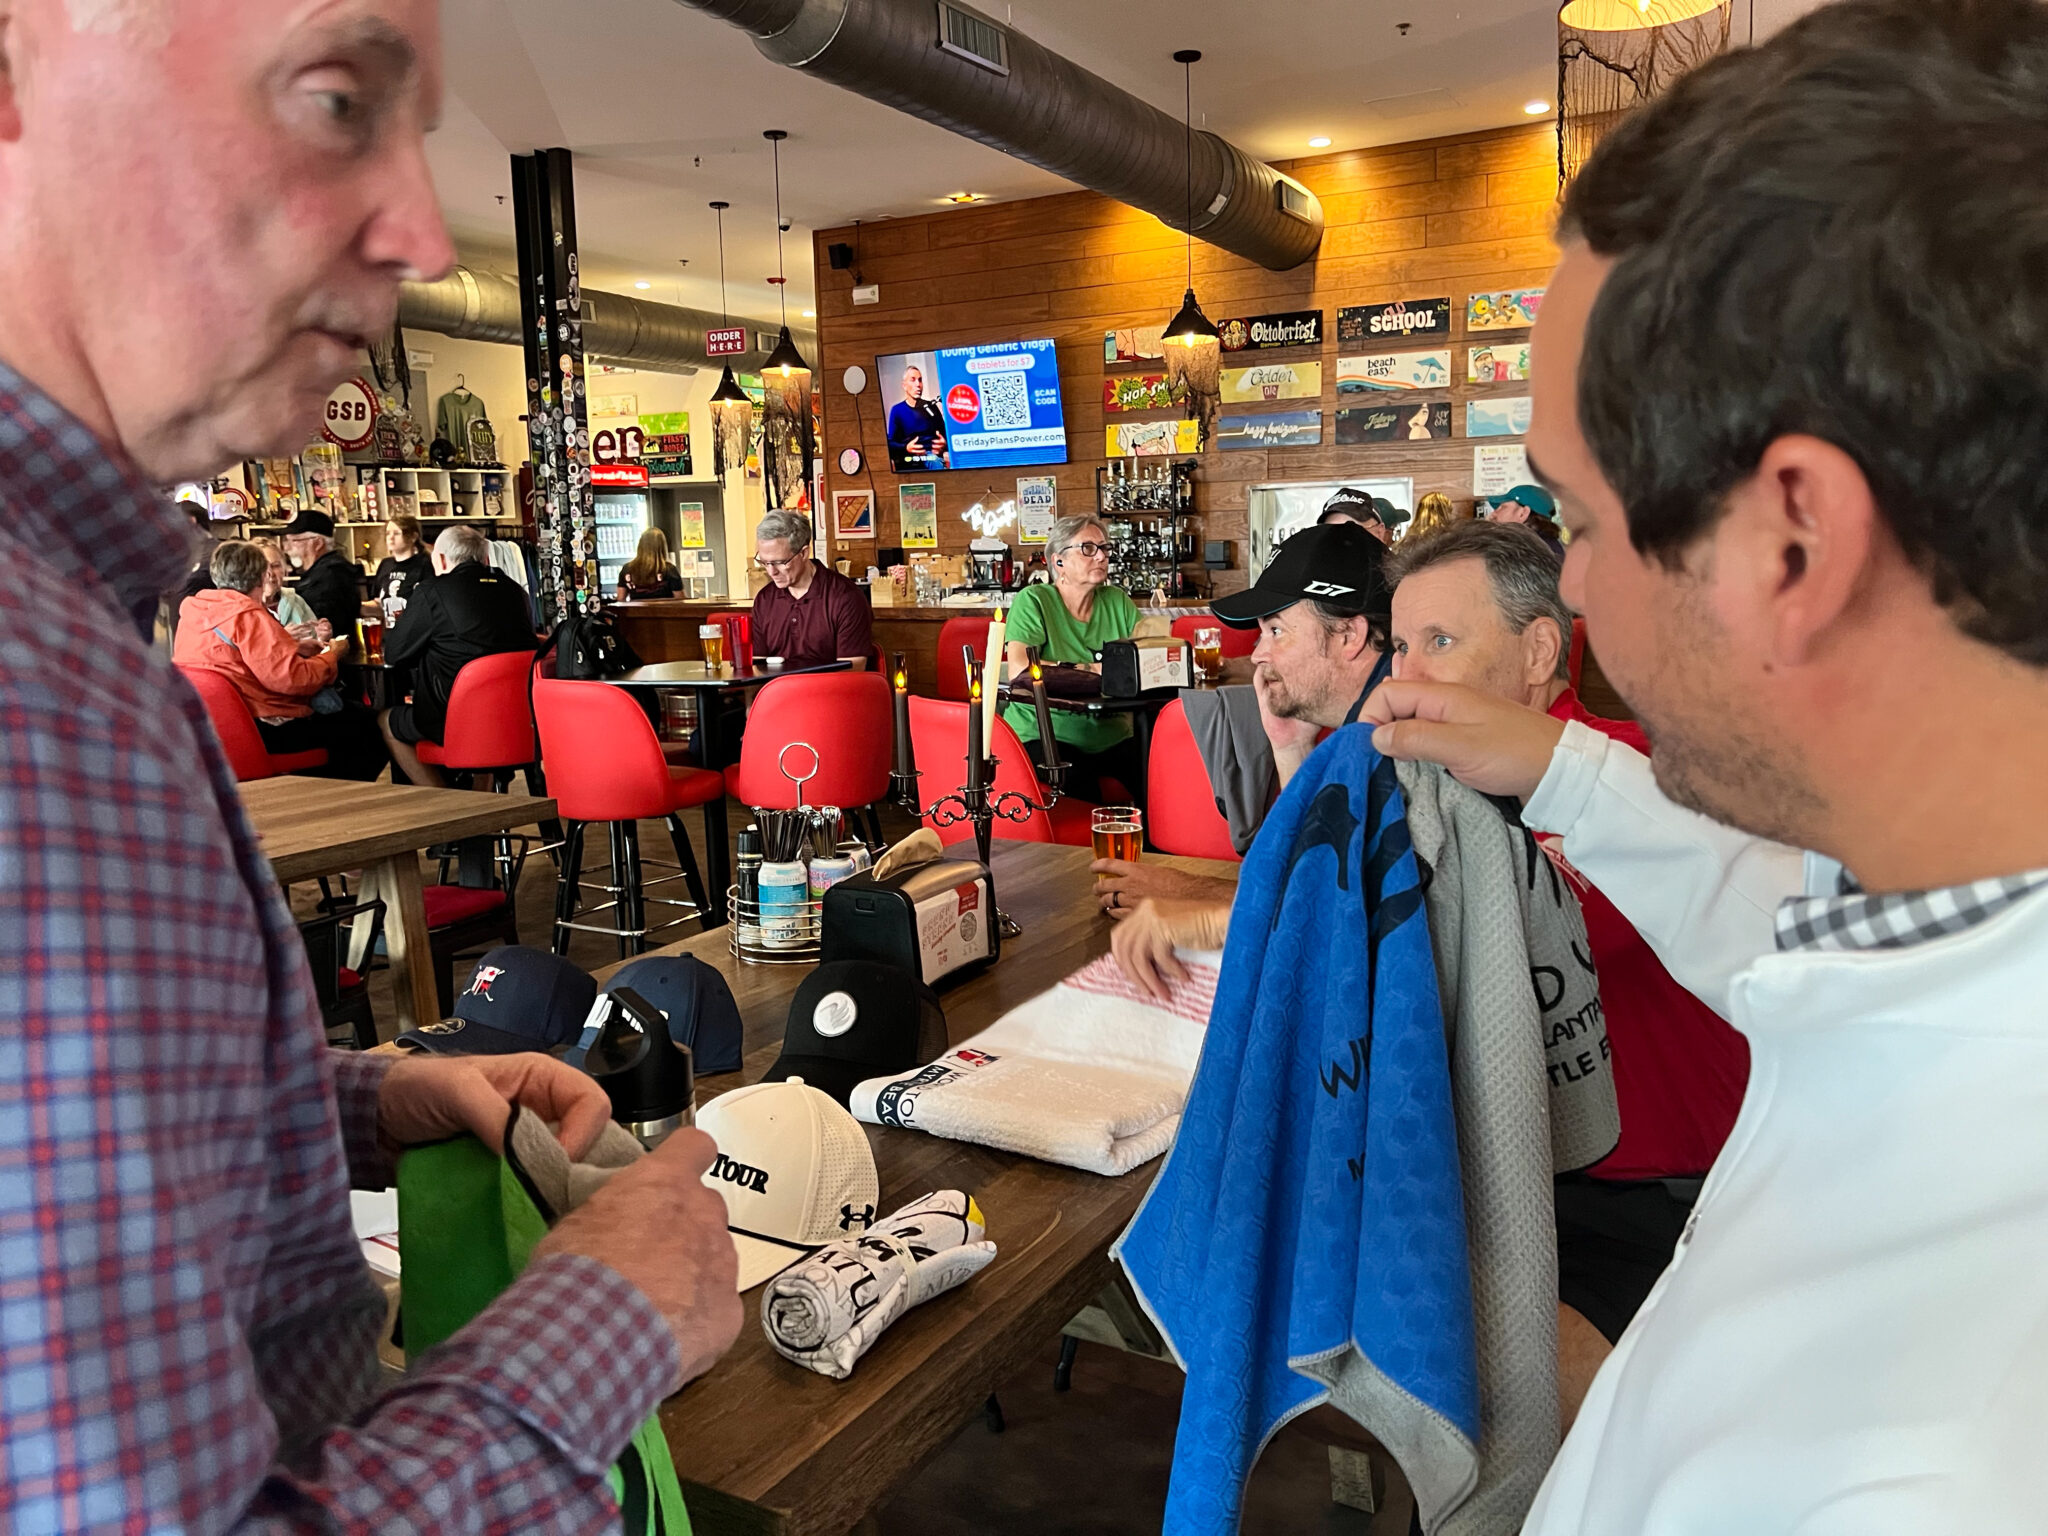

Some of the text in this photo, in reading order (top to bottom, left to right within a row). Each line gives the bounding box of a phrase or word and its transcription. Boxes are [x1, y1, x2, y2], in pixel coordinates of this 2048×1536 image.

[1370, 309, 1436, 333] SCHOOL
[709, 331, 741, 342] ORDER
[1250, 318, 1317, 343] Oktoberfest
[977, 361, 1005, 370] tablets
[1007, 358, 1018, 367] for
[1367, 357, 1396, 369] beach
[1367, 366, 1390, 377] easy
[1034, 388, 1056, 397] SCAN
[1123, 387, 1147, 404] HOP
[1035, 397, 1057, 405] CODE
[326, 400, 367, 422] GSB
[1243, 421, 1300, 439] hazy horizon
[663, 435, 685, 444] FIRST
[963, 434, 1065, 447] FridayPlansPower.com
[1264, 436, 1278, 445] IPA
[1024, 495, 1052, 505] DEAD
[710, 1153, 769, 1195] TOUR
